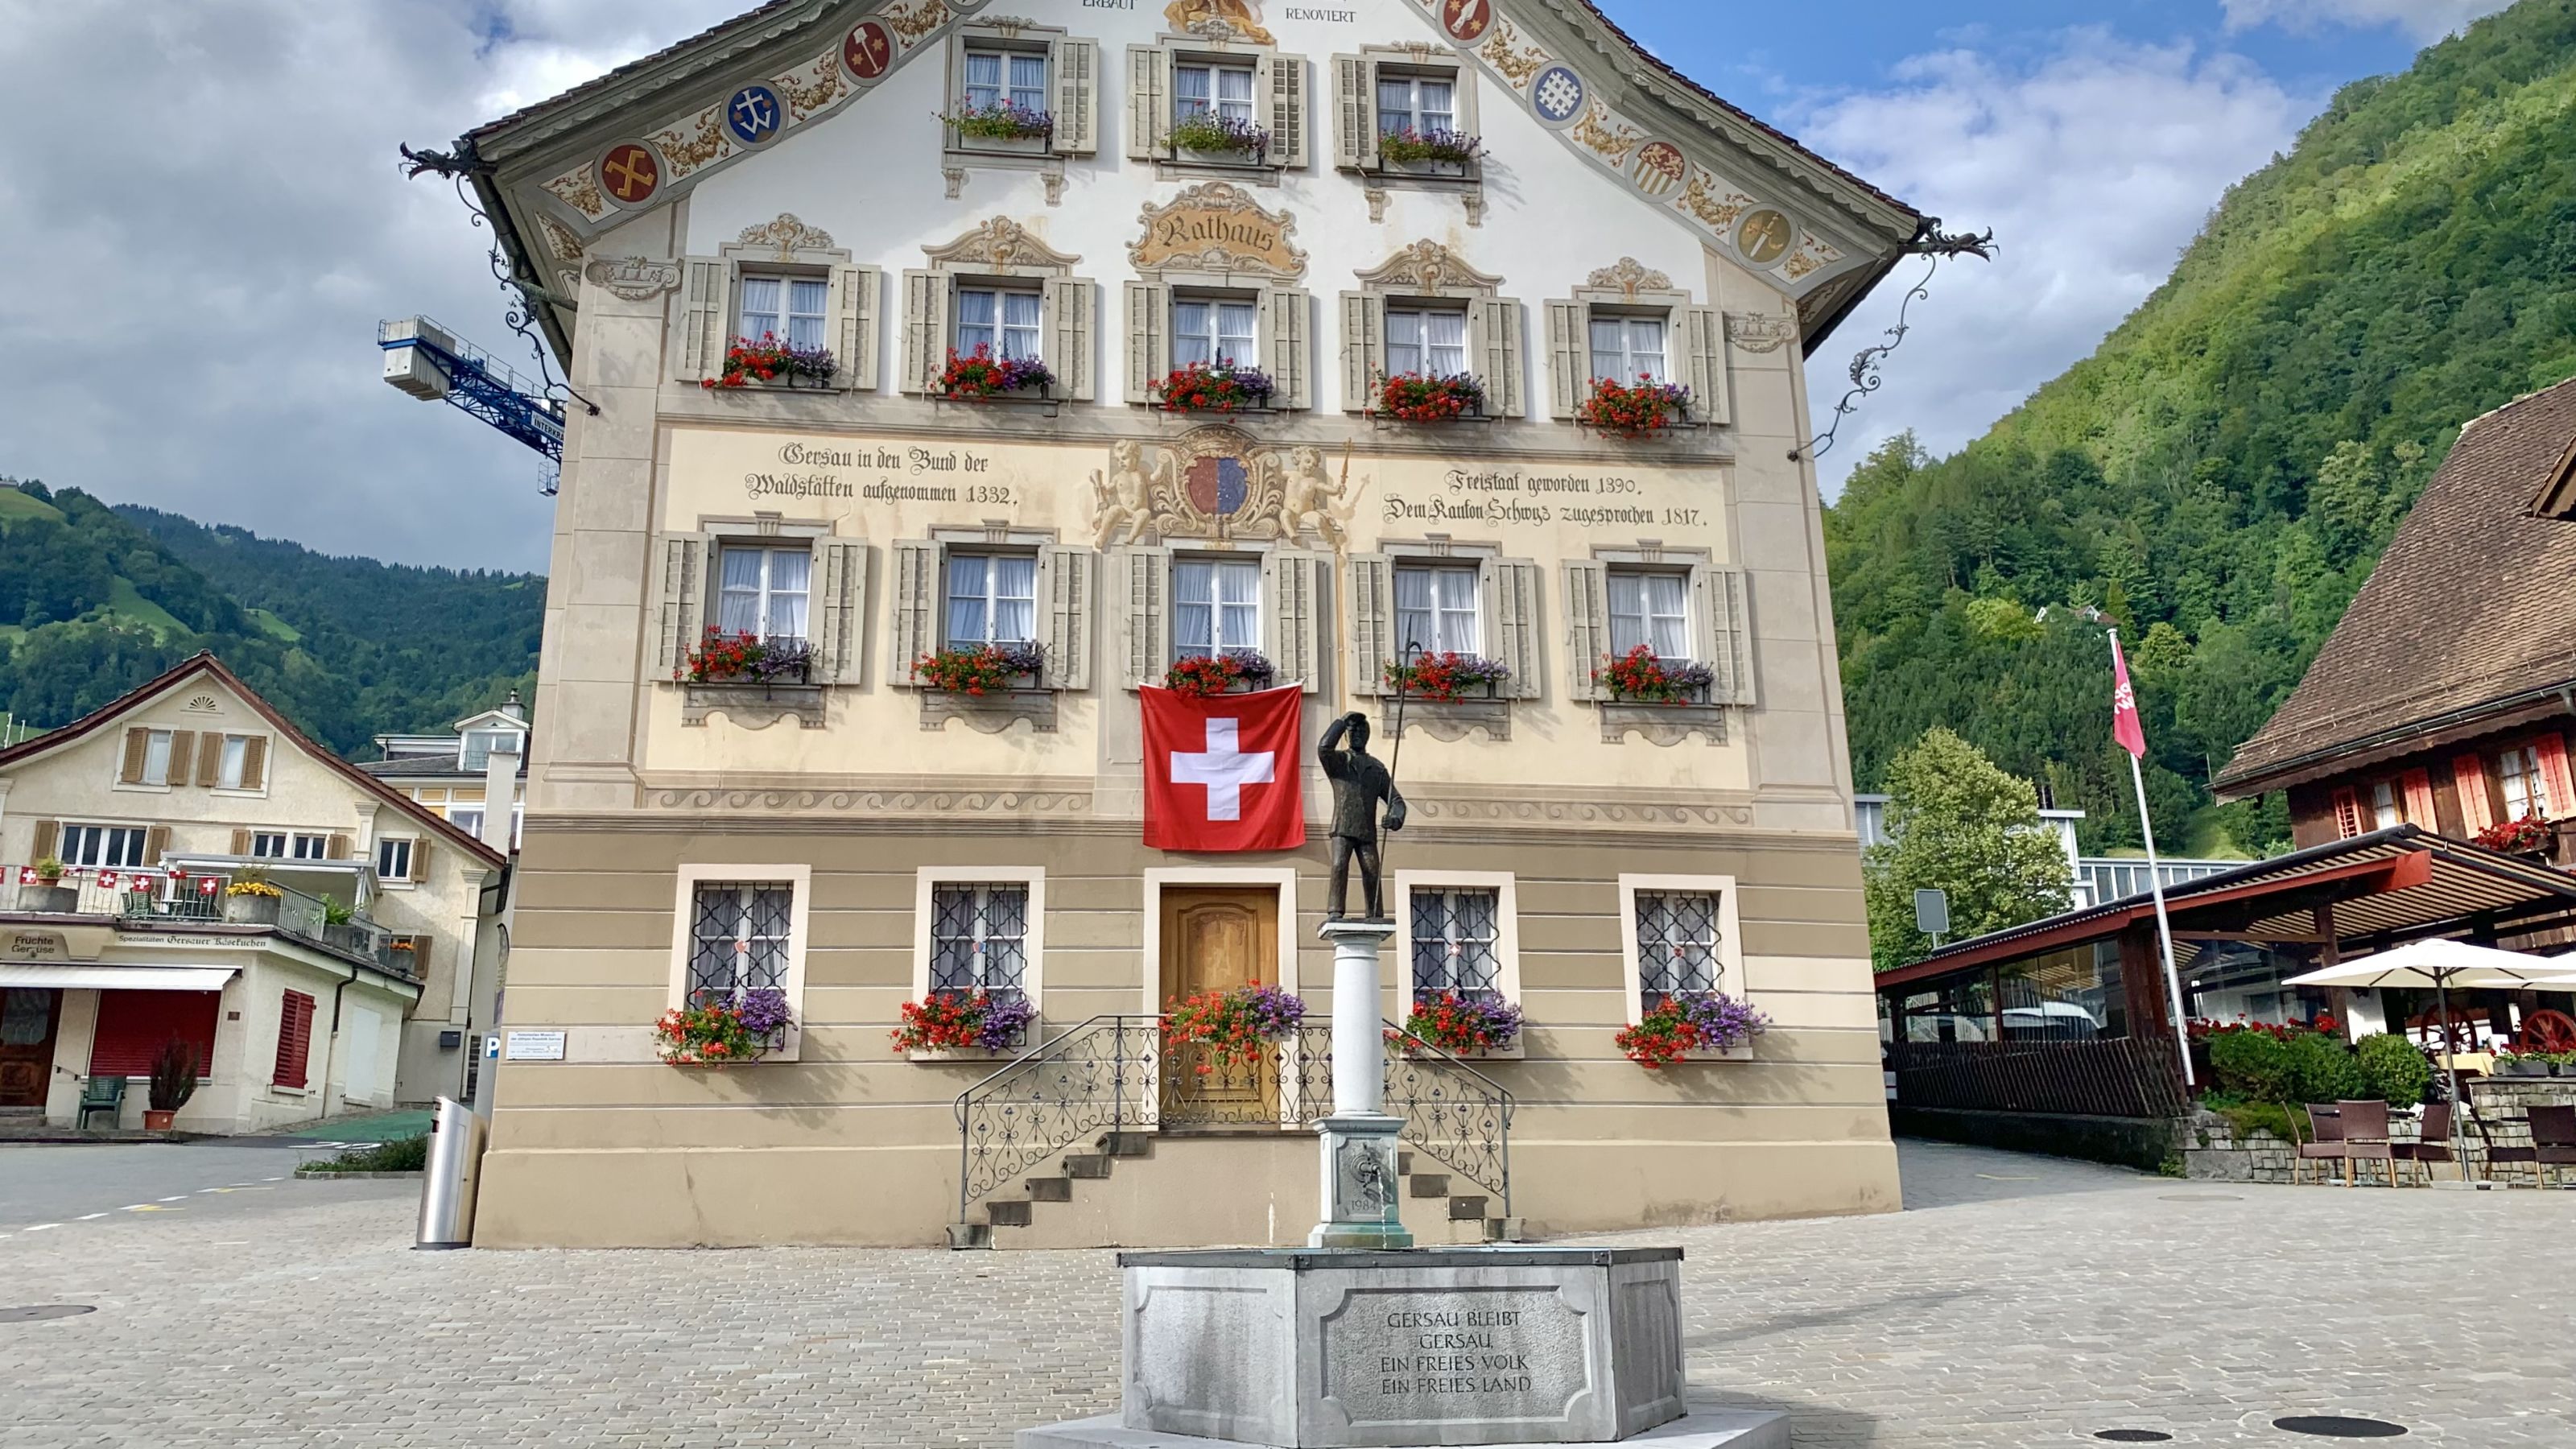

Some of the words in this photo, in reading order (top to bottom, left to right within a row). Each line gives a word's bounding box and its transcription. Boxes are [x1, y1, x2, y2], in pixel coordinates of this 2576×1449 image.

[1286, 8, 1357, 23] RENOVIERT
[1157, 214, 1276, 253] Rathaus
[778, 442, 852, 469] Gersau
[857, 449, 873, 468] in
[877, 446, 901, 469] den
[908, 446, 956, 476] Bund
[964, 451, 989, 473] der
[745, 473, 854, 500] Waldstätten
[862, 476, 956, 506] aufgenommen
[1444, 469, 1521, 496] Freistaat
[1527, 473, 1590, 497] geworden
[1596, 477, 1642, 495] 1390.
[1382, 493, 1426, 524] Dem
[1427, 493, 1484, 525] Kanton
[1484, 497, 1551, 527] Schwyz
[1559, 505, 1654, 527] zugesprochen
[1661, 508, 1707, 527] 1817.
[14, 935, 54, 945] Früchte
[118, 935, 164, 943] Spezialitäten
[167, 935, 211, 946] Gersauer
[485, 1037, 500, 1057] P
[1387, 1312, 1459, 1328] GERSAU
[1468, 1311, 1521, 1327] BLEIBT
[1381, 1357, 1410, 1373] EIN
[1417, 1356, 1475, 1372] FREIES
[1481, 1354, 1529, 1370] VOLK
[1382, 1379, 1410, 1394] EIN
[1417, 1377, 1476, 1393] FREIES
[1483, 1377, 1531, 1391] LAND
